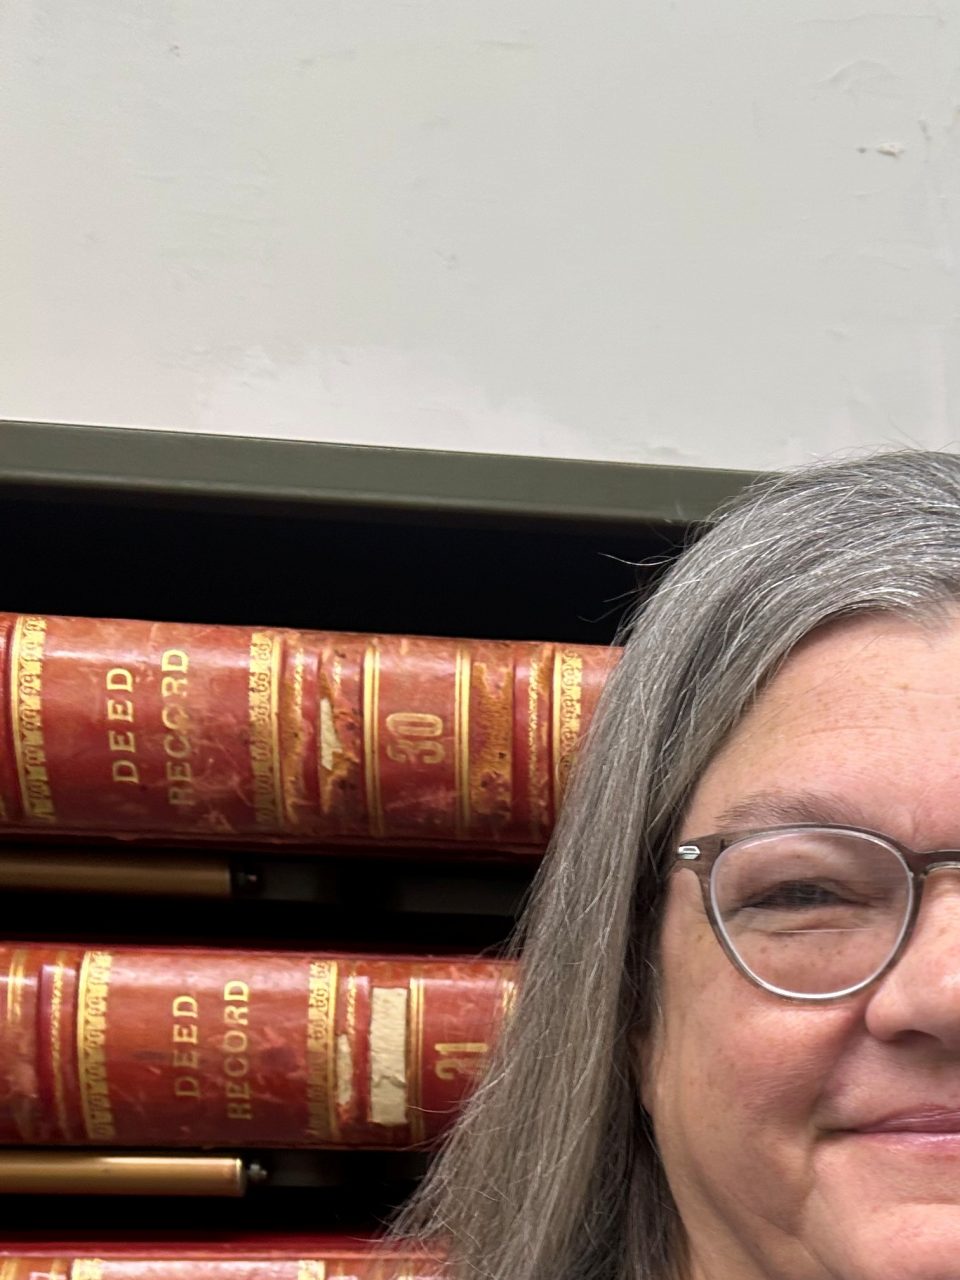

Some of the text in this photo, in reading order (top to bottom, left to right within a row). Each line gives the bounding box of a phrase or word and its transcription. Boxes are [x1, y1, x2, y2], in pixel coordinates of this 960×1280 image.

[106, 667, 139, 784] DEED
[161, 648, 195, 806] RECORD
[386, 711, 445, 764] 30
[172, 994, 199, 1098] DEED
[223, 979, 252, 1120] RECORD
